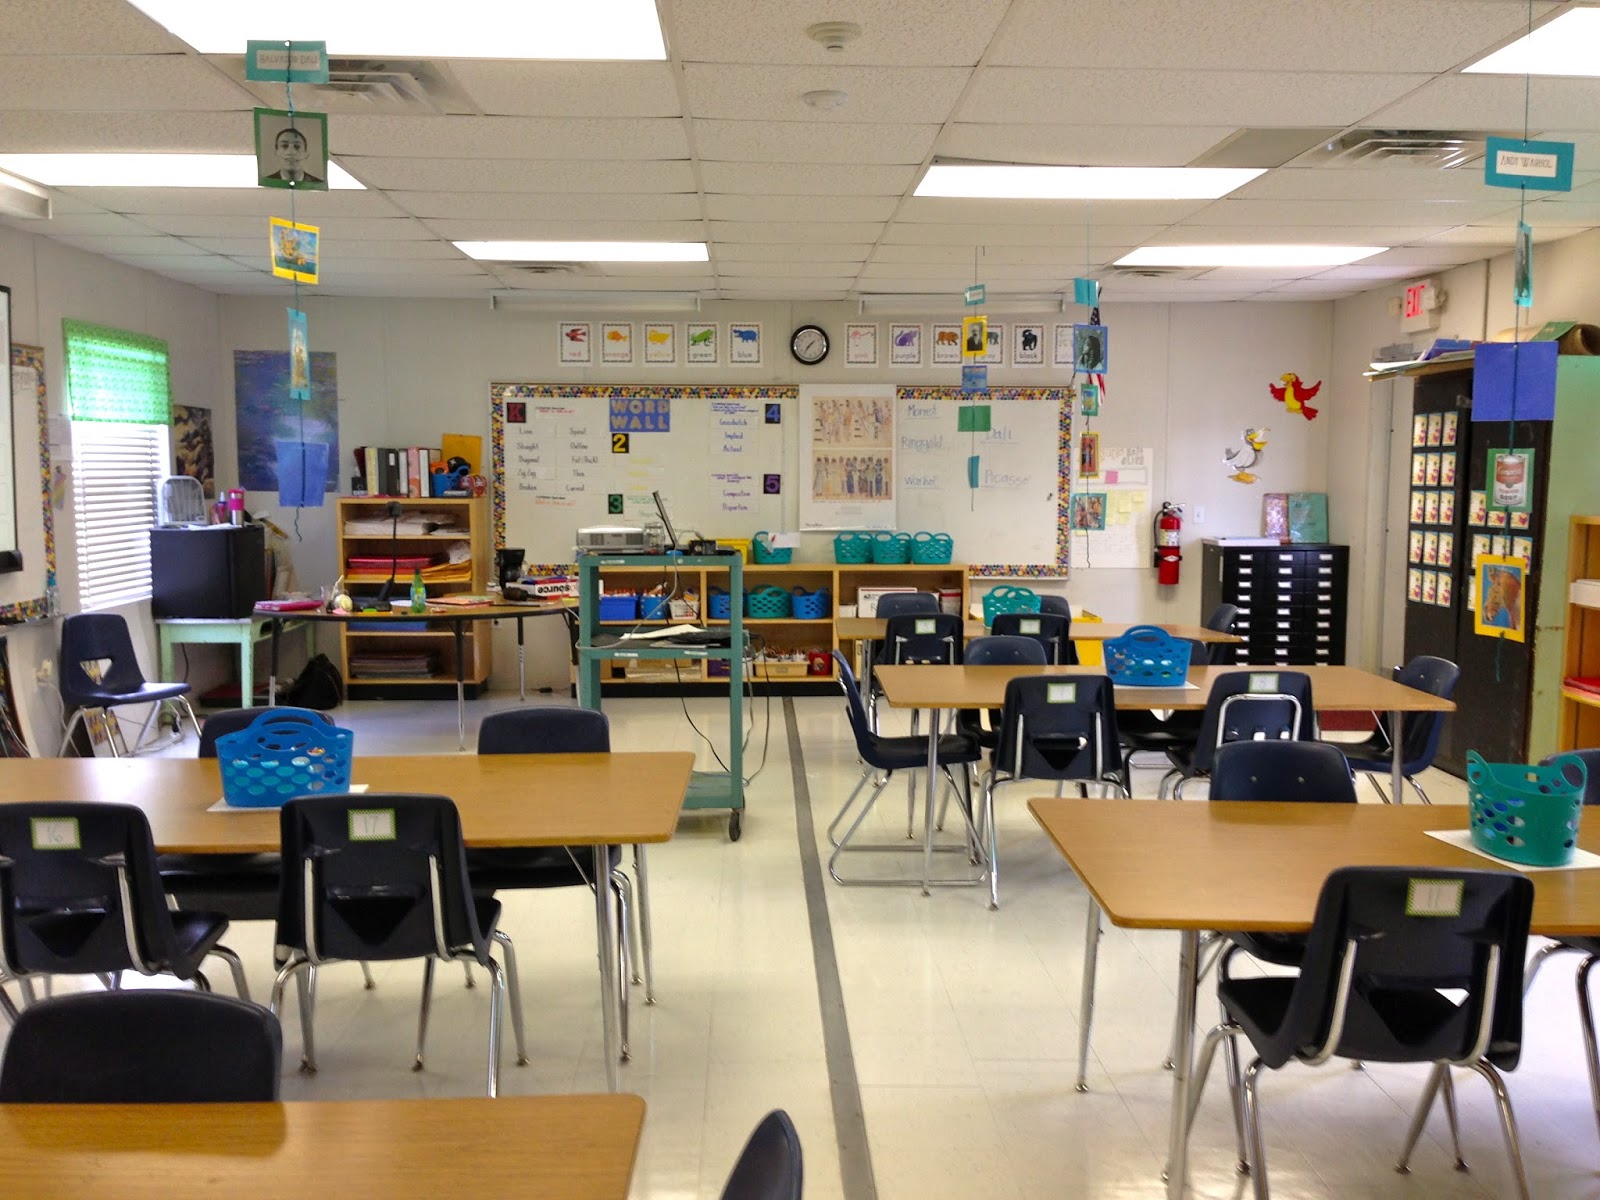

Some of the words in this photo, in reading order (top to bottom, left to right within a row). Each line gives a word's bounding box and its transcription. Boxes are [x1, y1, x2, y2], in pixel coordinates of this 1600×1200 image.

[605, 352, 630, 360] orange
[692, 352, 713, 360] green
[895, 351, 917, 361] purple
[1019, 351, 1038, 359] black
[509, 404, 522, 422] K
[611, 400, 669, 414] WORD
[766, 404, 780, 422] 4
[907, 404, 936, 416] Monet
[611, 416, 668, 429] WALL
[613, 434, 626, 452] 2
[901, 435, 943, 453] Ringgold
[764, 475, 780, 492] 5
[904, 475, 937, 486] Warhol
[609, 495, 622, 512] 3
[364, 814, 379, 834] 17
[47, 823, 64, 844] 16
